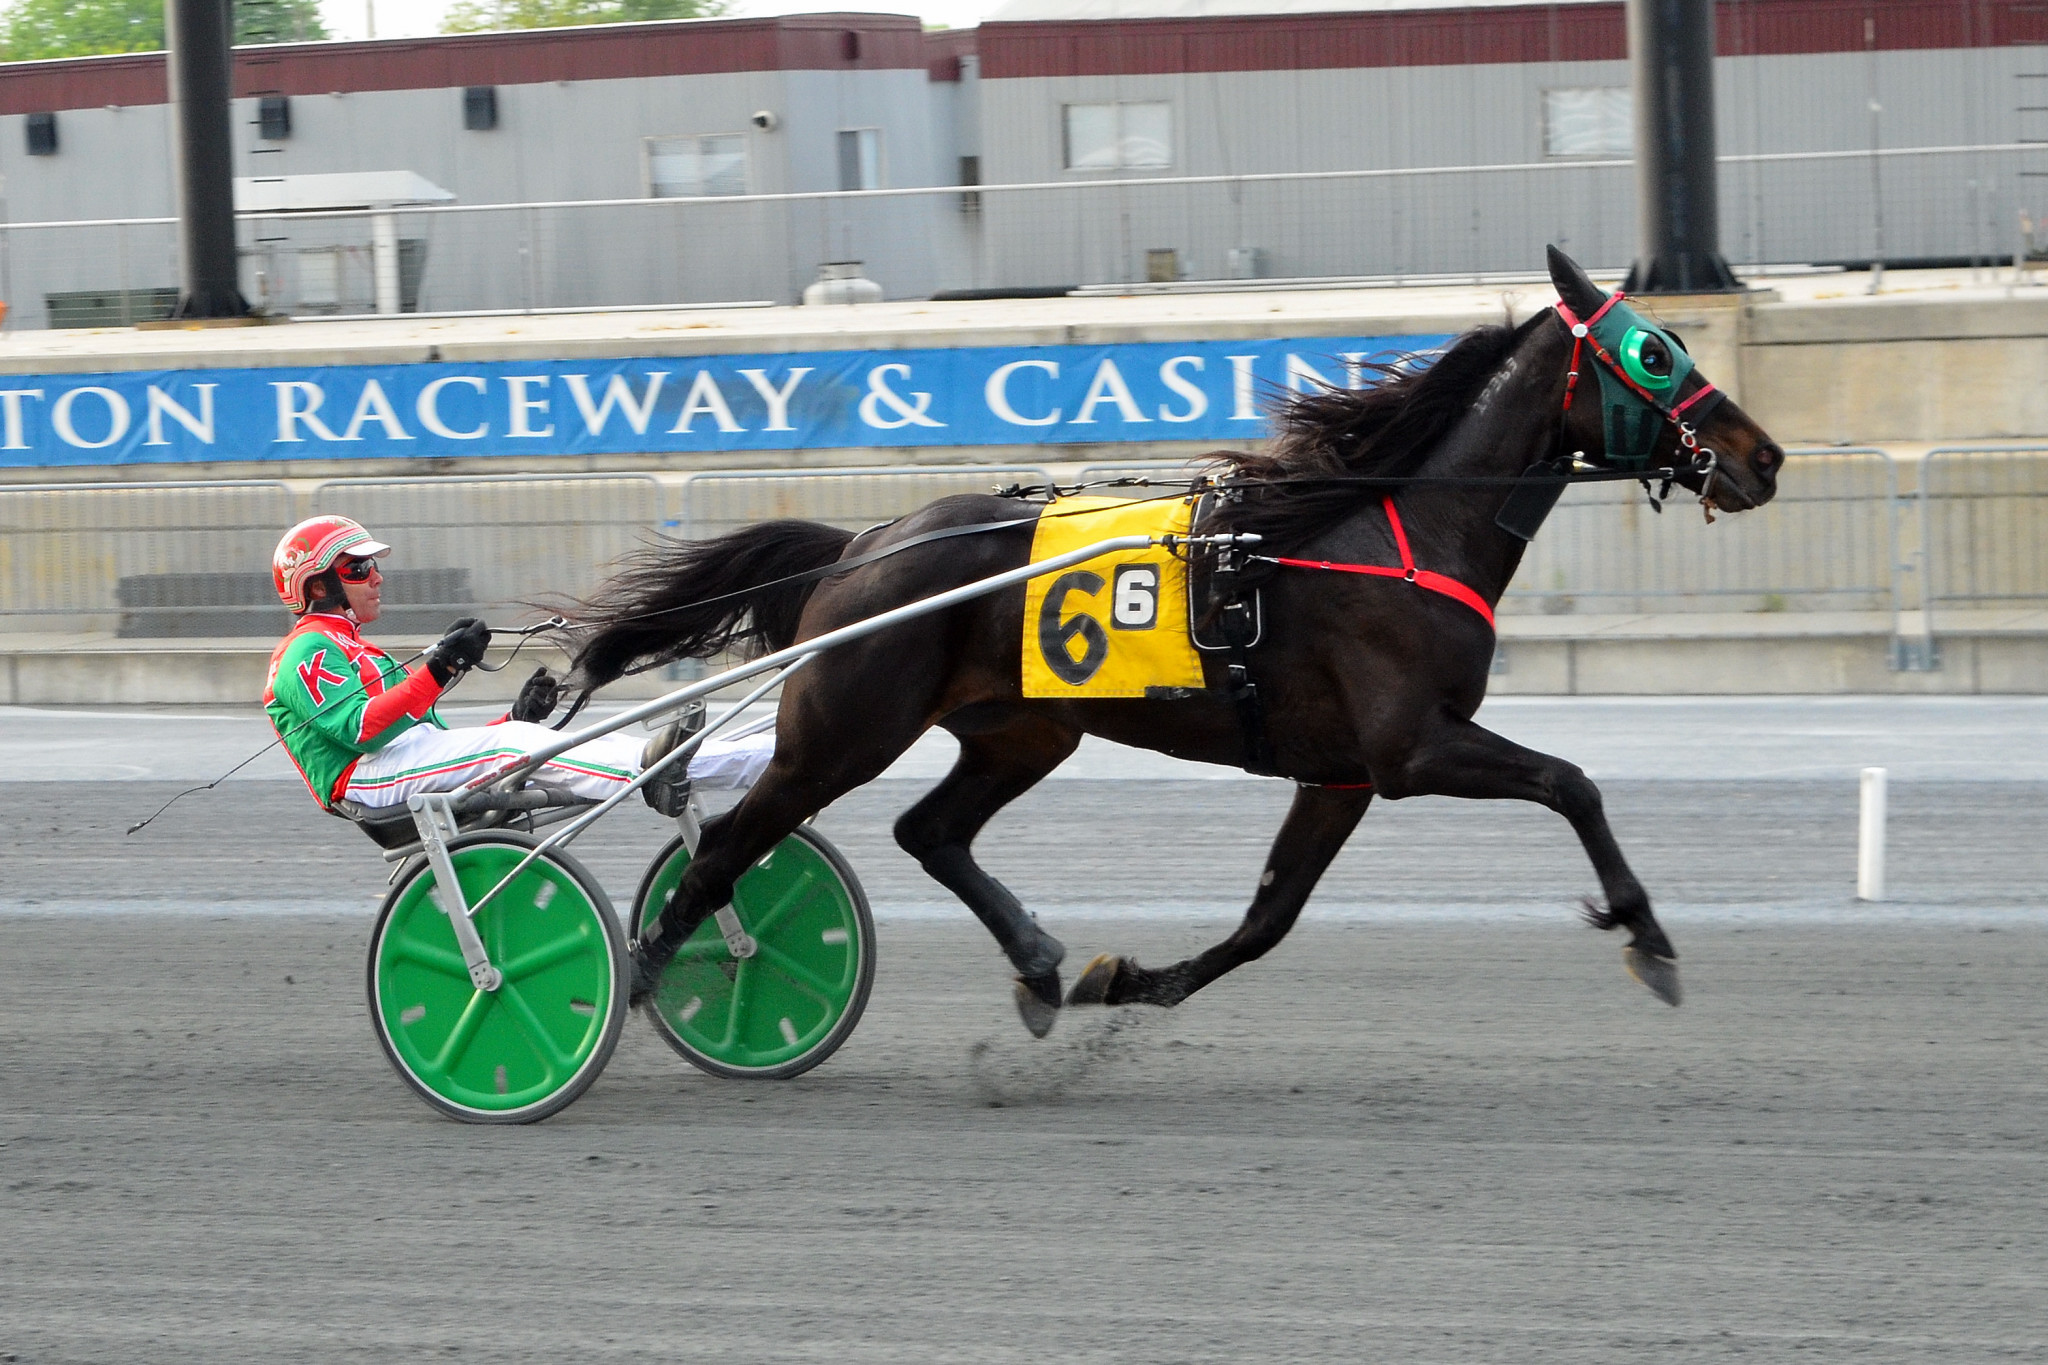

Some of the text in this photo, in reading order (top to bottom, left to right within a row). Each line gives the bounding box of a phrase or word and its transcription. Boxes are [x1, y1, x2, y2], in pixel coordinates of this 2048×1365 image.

[0, 348, 1450, 450] TON RACEWAY & CASIN
[1038, 570, 1110, 687] 6
[1115, 569, 1157, 625] 6
[296, 648, 350, 708] K
